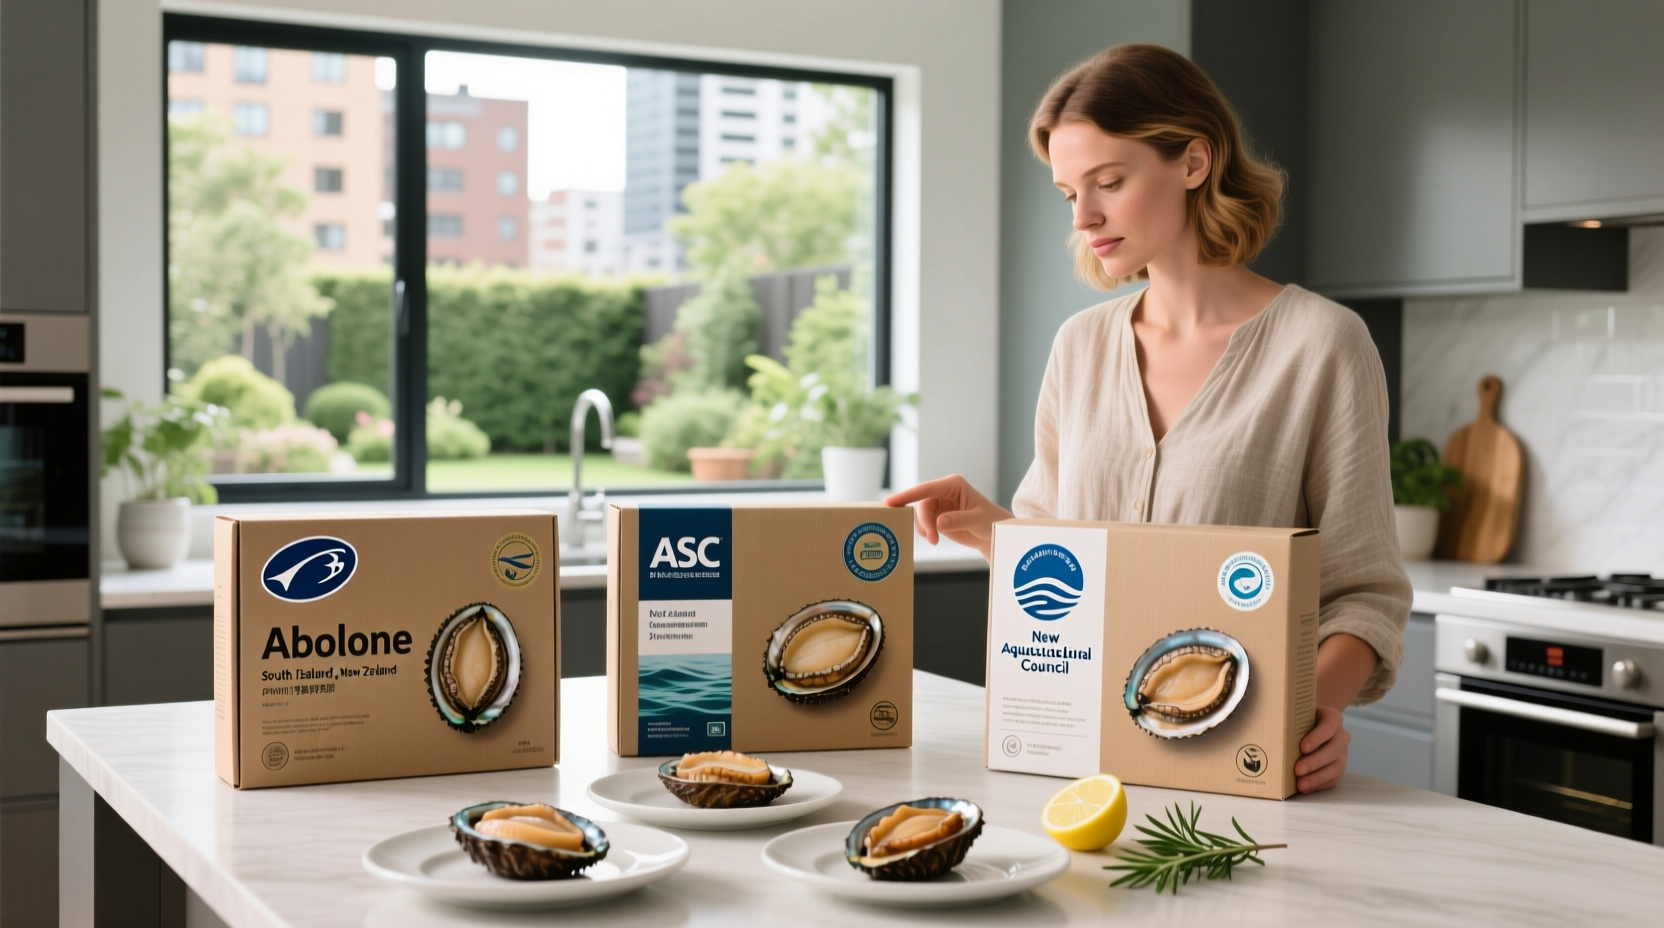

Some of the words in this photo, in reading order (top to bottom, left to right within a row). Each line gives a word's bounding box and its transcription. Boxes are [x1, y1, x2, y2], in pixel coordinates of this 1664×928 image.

[649, 536, 721, 568] ASC
[261, 623, 413, 660] Abolone
[1032, 630, 1060, 643] New
[1021, 658, 1069, 674] Council
[261, 669, 292, 681] South
